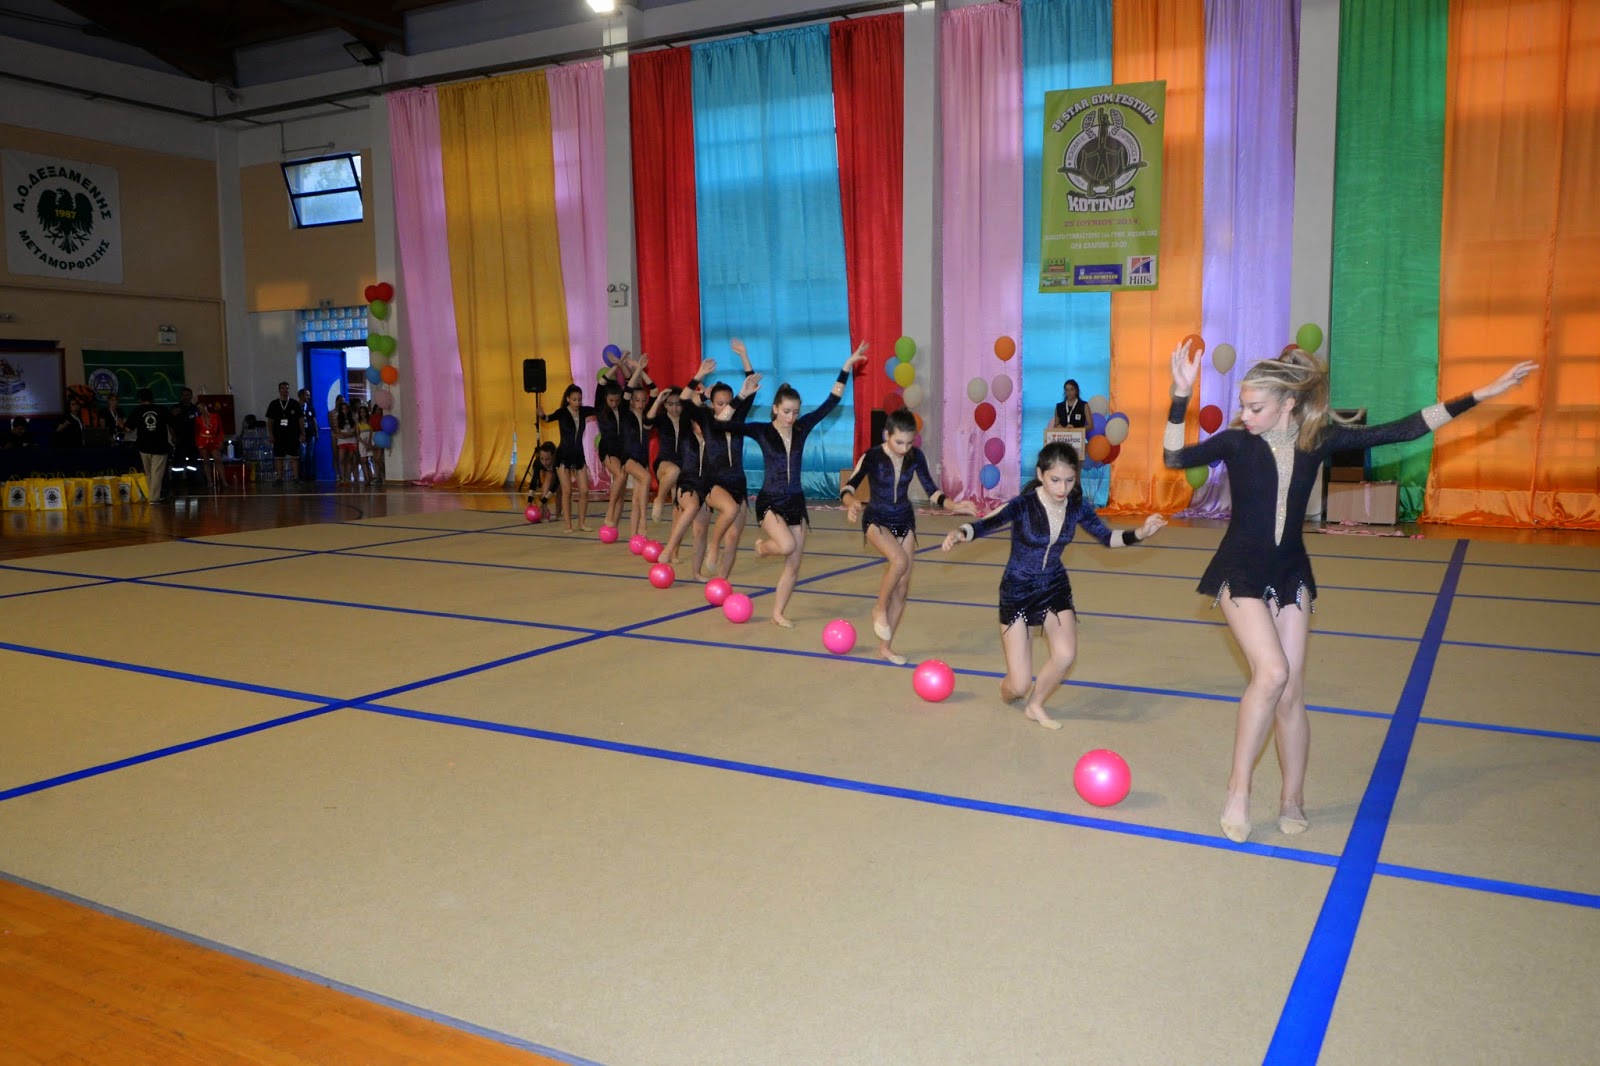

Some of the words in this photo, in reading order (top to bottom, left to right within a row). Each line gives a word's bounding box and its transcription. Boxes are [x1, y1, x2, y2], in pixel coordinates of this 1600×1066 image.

[1062, 99, 1090, 121] STAR
[1091, 93, 1114, 105] GYM
[1114, 93, 1159, 125] FESTIVAL
[55, 209, 76, 219] 1987
[19, 229, 110, 271] ΜΕΤΑΜΟΡΦΩΣΗΣ
